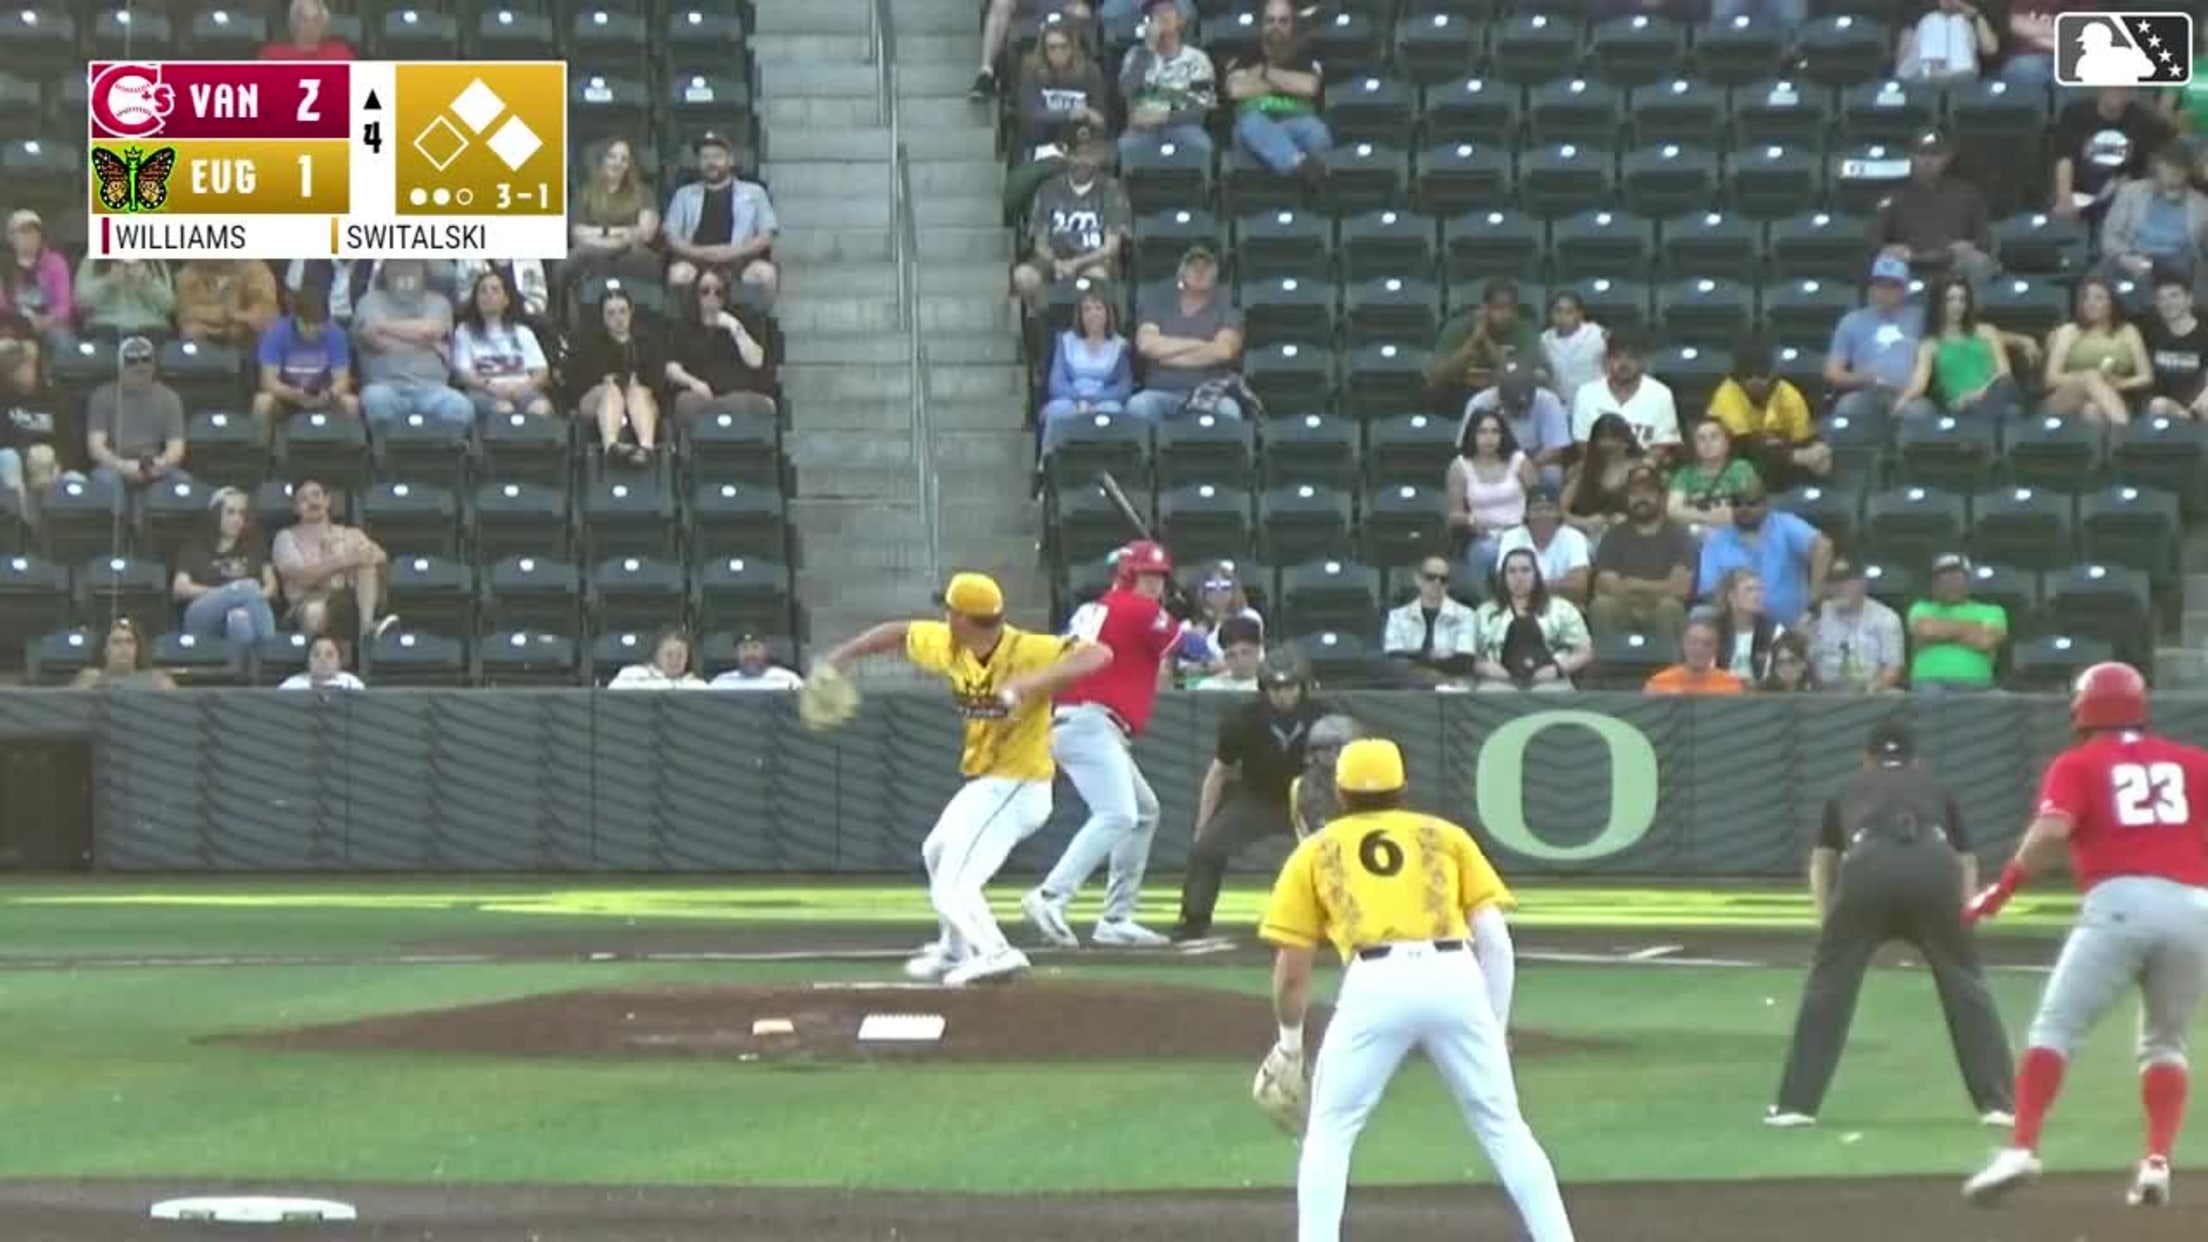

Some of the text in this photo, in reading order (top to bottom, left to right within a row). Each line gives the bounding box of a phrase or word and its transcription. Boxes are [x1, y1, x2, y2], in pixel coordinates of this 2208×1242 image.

[1476, 710, 1658, 860] O
[2112, 762, 2189, 825] 23
[1359, 829, 1404, 876] 6
